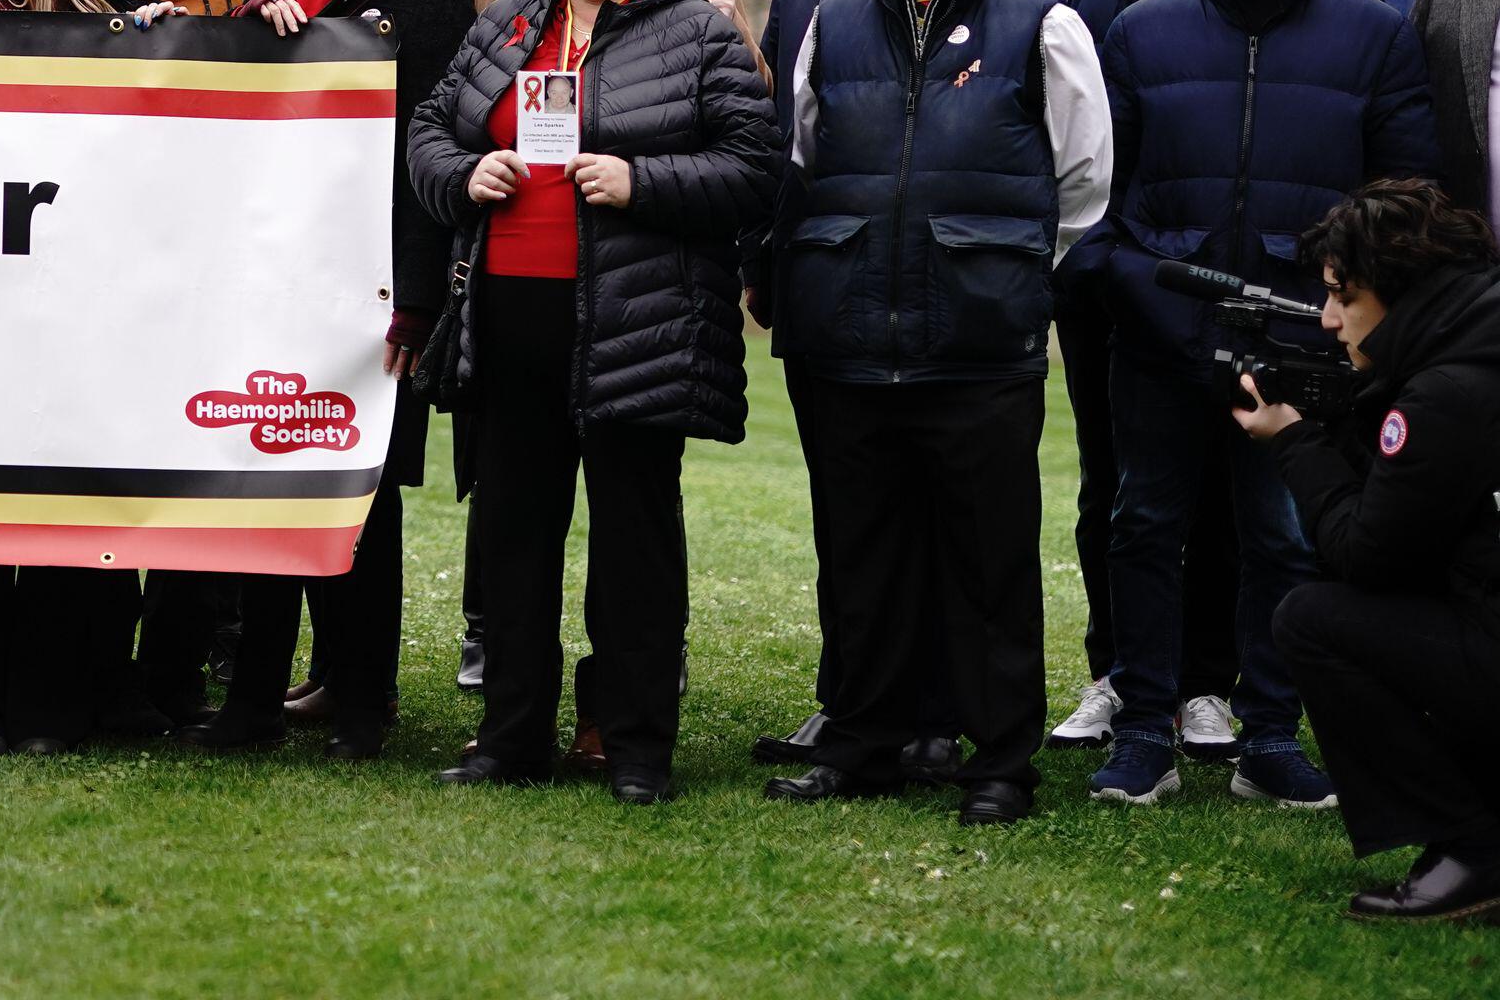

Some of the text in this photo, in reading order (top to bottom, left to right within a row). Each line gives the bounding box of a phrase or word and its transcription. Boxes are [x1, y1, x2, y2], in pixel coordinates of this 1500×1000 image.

[1188, 265, 1240, 288] RØDE
[252, 375, 298, 396] The
[196, 398, 346, 424] Haemophilia
[260, 422, 351, 447] Society
